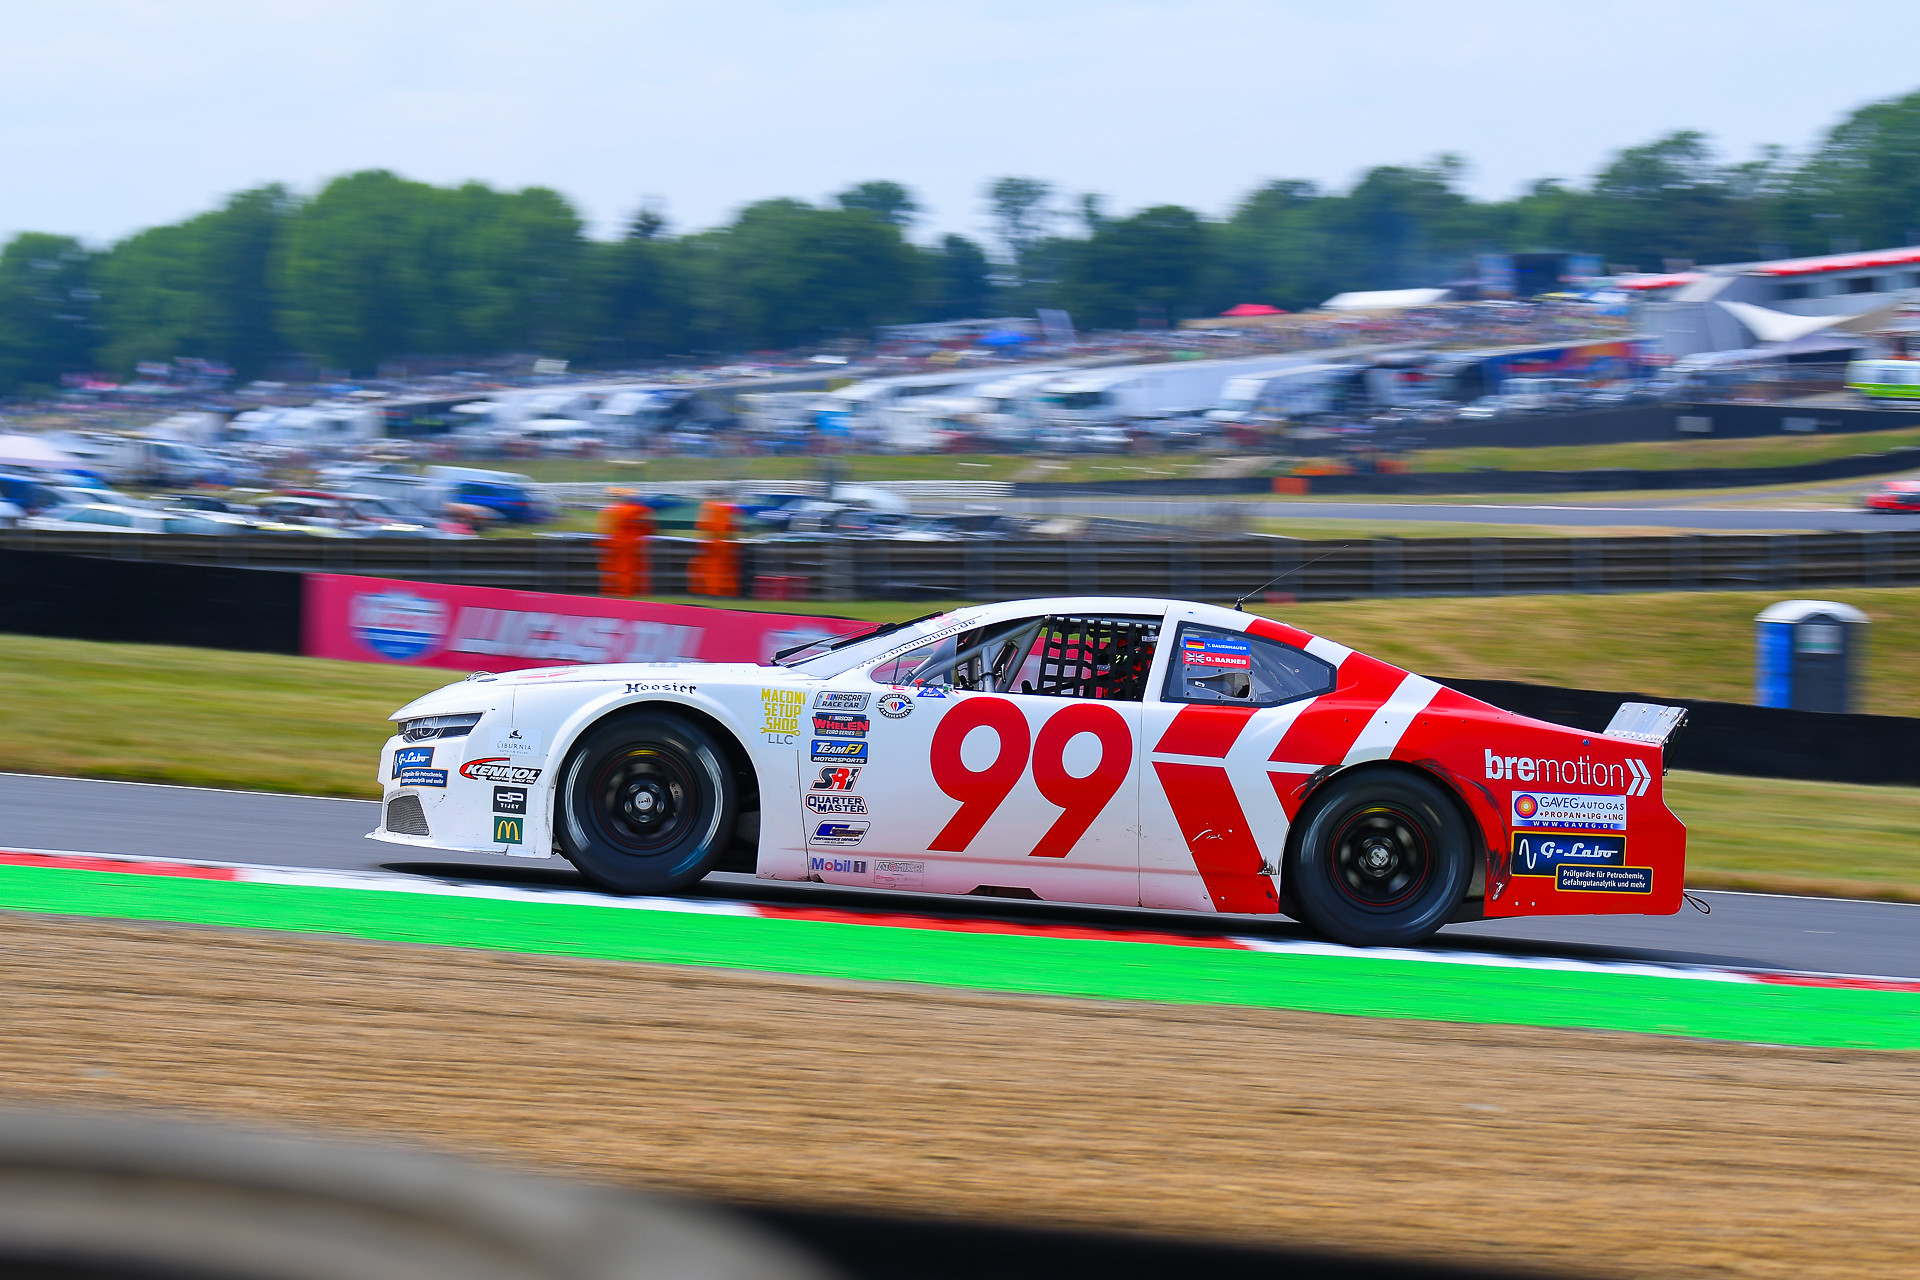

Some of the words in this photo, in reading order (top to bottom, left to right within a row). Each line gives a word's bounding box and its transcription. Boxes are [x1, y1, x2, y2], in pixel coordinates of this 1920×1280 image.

[855, 619, 977, 670] www.bremotion.de
[1215, 657, 1247, 665] BARNES
[622, 682, 697, 695] Hoosier
[761, 688, 806, 705] MACONI
[833, 694, 862, 702] NASCAR
[764, 702, 802, 718] SETUP
[821, 700, 842, 708] RACE
[766, 717, 798, 730] SHOP
[812, 717, 869, 731] WHELEN
[767, 733, 794, 745] LLC
[812, 756, 866, 764] MOTORSPORTS
[464, 763, 537, 780] KENNOL
[1484, 748, 1625, 788] bremotion
[927, 696, 1133, 858] 99
[807, 796, 862, 807] QUARTER
[817, 803, 865, 813] MASTER
[1539, 796, 1579, 809] GAVEG
[1579, 802, 1625, 811] AUTOGAS
[1544, 811, 1581, 819] PROPAN
[1532, 820, 1615, 830] WWW.GAVEG.DE
[1540, 841, 1619, 859] G-Labo
[811, 857, 851, 873] Mobil
[853, 860, 867, 874] 1
[1562, 869, 1596, 879] Prüfgeräte
[1596, 870, 1606, 878] für
[1606, 871, 1645, 881] Petrochemie,
[1562, 878, 1617, 889] Gefahrgutanalytik
[1629, 881, 1646, 889] mehr
